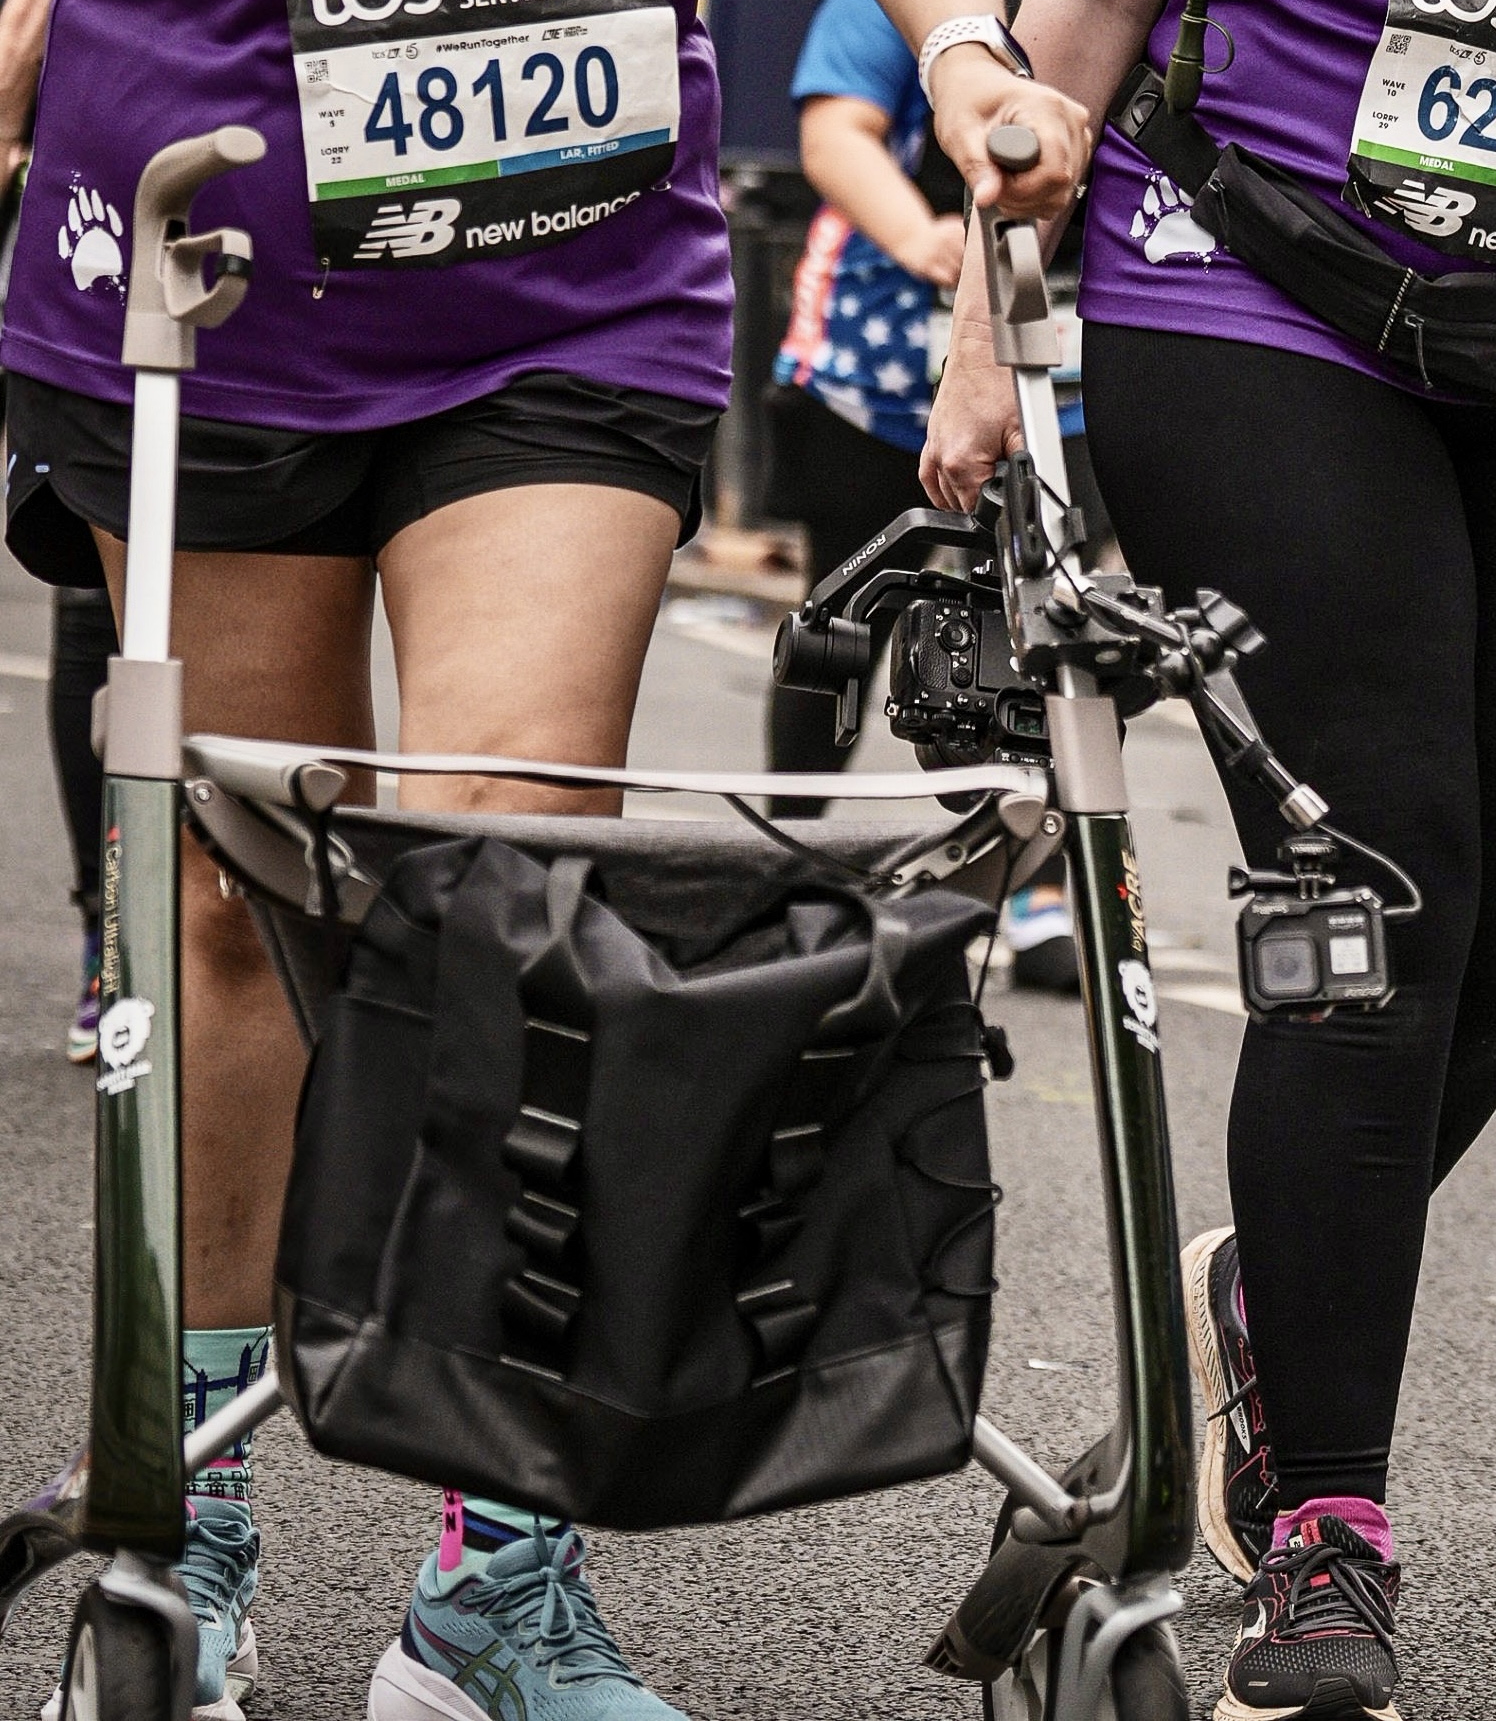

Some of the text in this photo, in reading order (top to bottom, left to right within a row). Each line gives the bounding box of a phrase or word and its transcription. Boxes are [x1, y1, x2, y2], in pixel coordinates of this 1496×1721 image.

[435, 32, 530, 54] #WeRunTogether
[1382, 78, 1406, 91] WAVE
[1387, 88, 1397, 97] 10
[364, 45, 619, 157] 48120
[318, 109, 345, 119] WAVE
[1372, 110, 1399, 123] LORRY
[1378, 121, 1389, 130] 29
[320, 146, 349, 156] LORRY
[588, 141, 619, 156] FITTED
[1419, 155, 1455, 172] MEDAL
[385, 174, 424, 188] MEDAL
[466, 217, 524, 249] new
[842, 534, 887, 576] RONIN
[105, 845, 122, 914] Carbon
[1237, 1406, 1248, 1440] BROOKS
